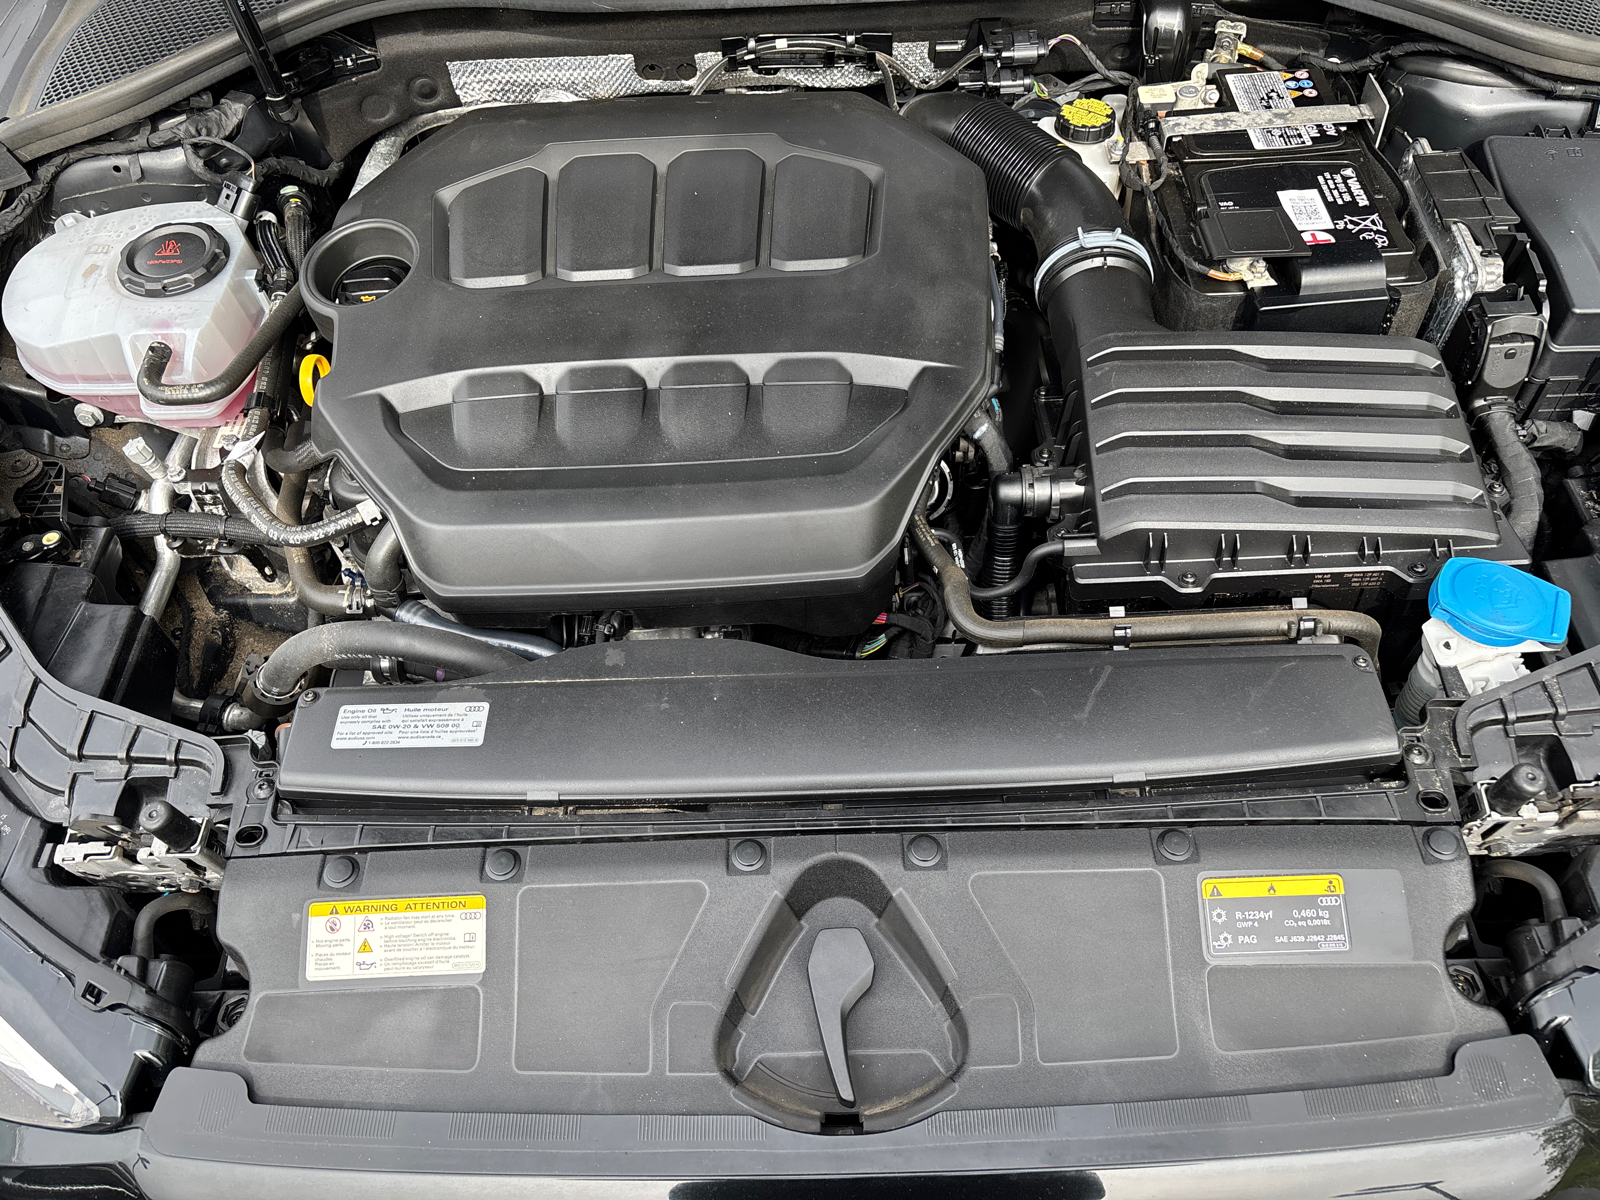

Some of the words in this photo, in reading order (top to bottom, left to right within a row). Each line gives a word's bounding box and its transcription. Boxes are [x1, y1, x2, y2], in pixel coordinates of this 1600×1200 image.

[1347, 177, 1369, 207] VARTA
[1334, 220, 1344, 229] Pb
[343, 903, 398, 914] WARNING
[404, 900, 467, 911] ATTENTION
[1235, 910, 1273, 921] R-1234yf
[1293, 909, 1317, 919] 0,460
[1318, 909, 1329, 918] kg
[1238, 935, 1258, 944] PAG
